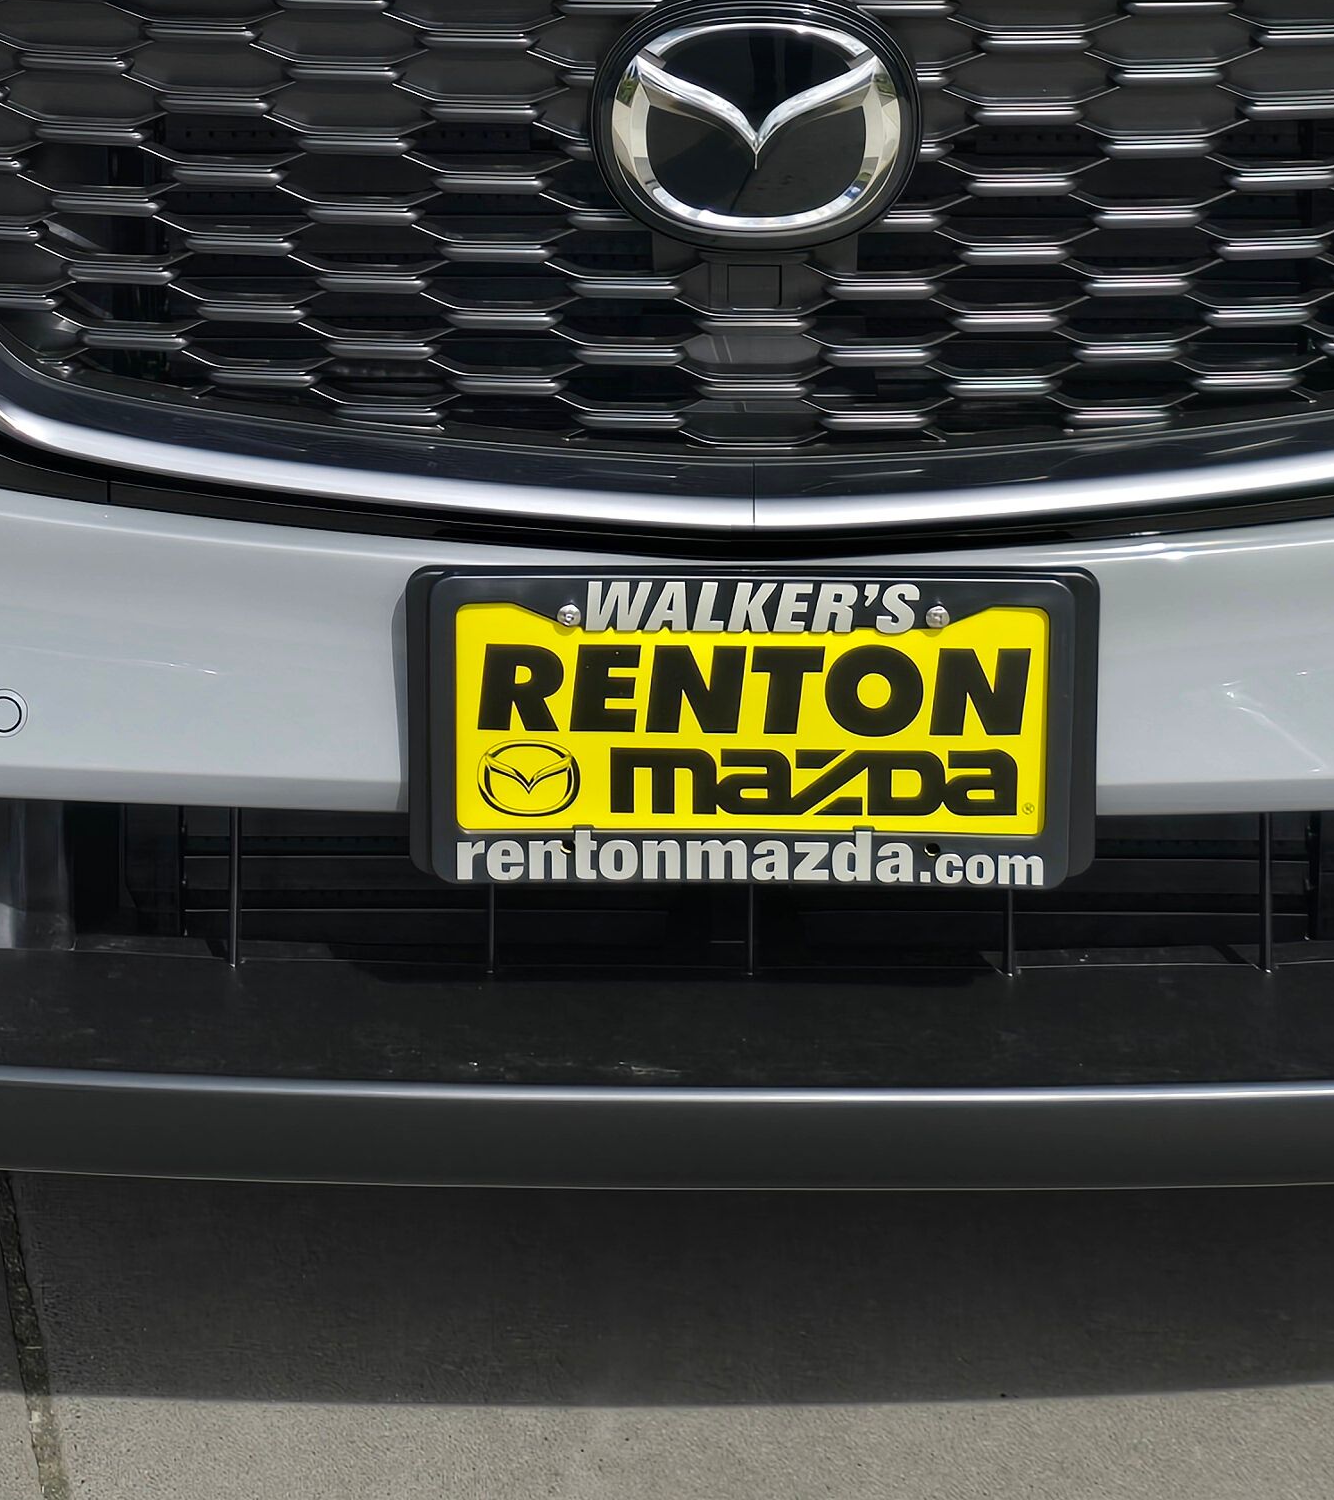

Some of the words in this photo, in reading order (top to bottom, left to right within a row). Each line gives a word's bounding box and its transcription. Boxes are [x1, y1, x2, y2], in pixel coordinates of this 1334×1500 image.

[584, 580, 922, 635] WALKER'S
[477, 643, 1032, 738] RENTON
[455, 830, 1045, 887] rentonmazda.com
